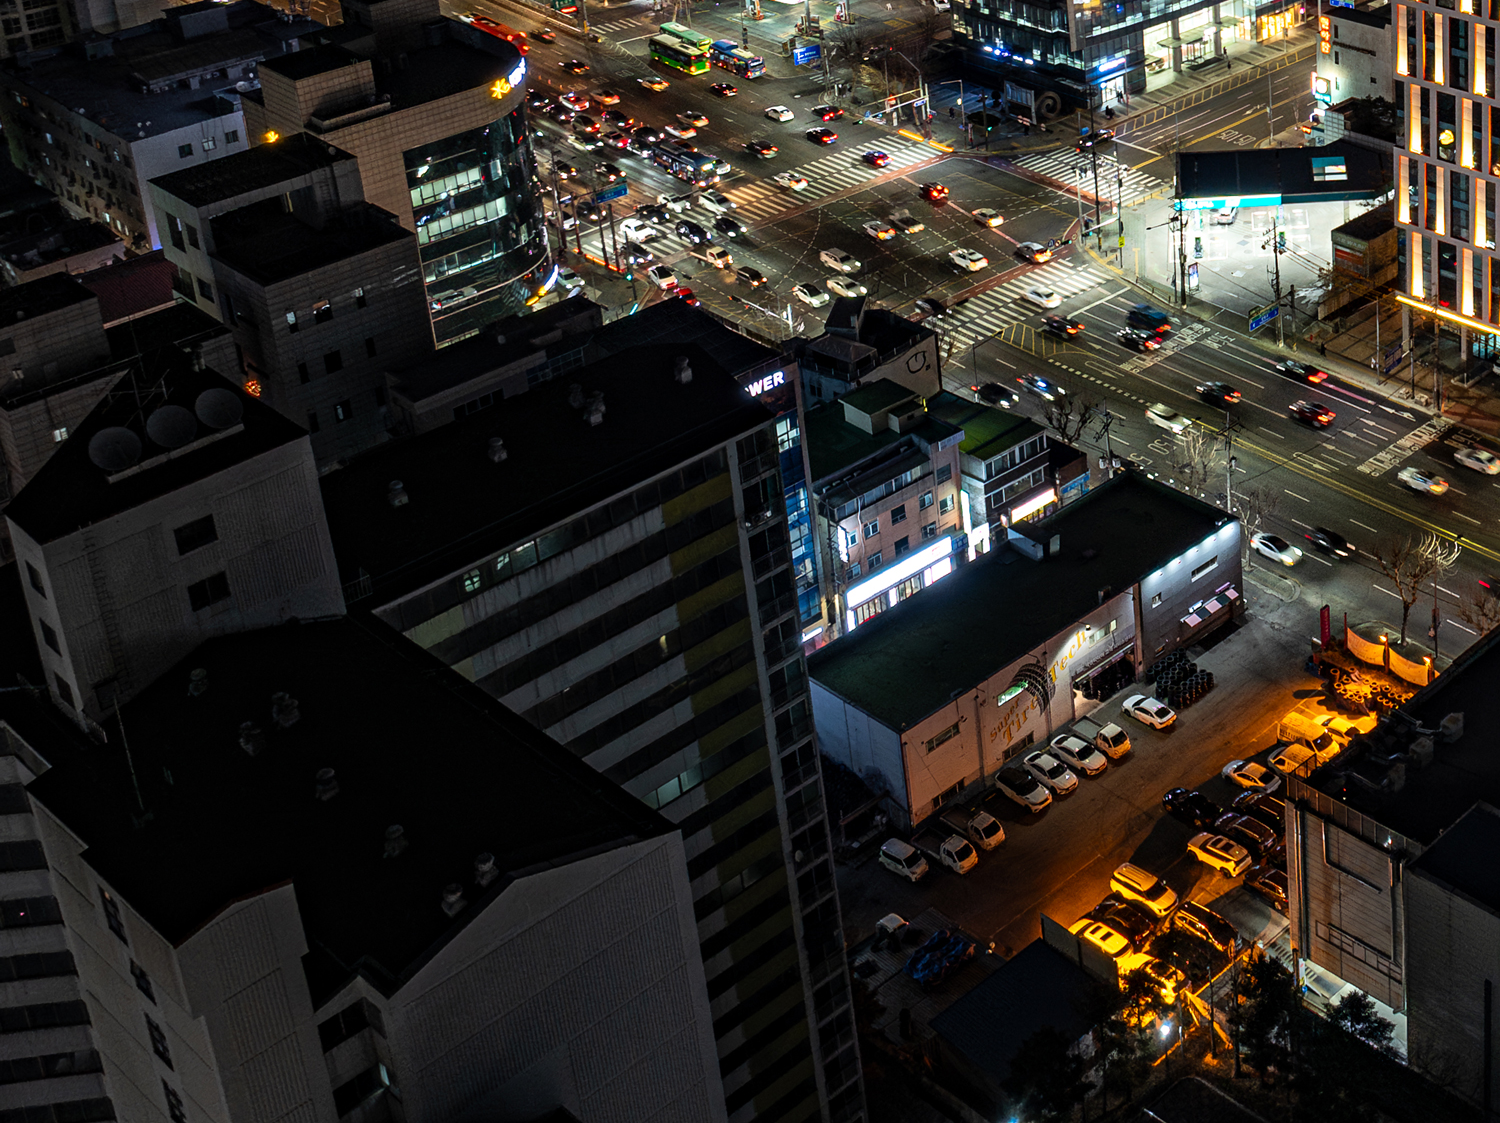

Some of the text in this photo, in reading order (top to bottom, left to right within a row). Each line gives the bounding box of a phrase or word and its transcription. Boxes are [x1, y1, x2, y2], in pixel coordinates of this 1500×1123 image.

[744, 370, 785, 397] WER
[1047, 630, 1087, 684] Tech
[1003, 695, 1039, 746] Tire
